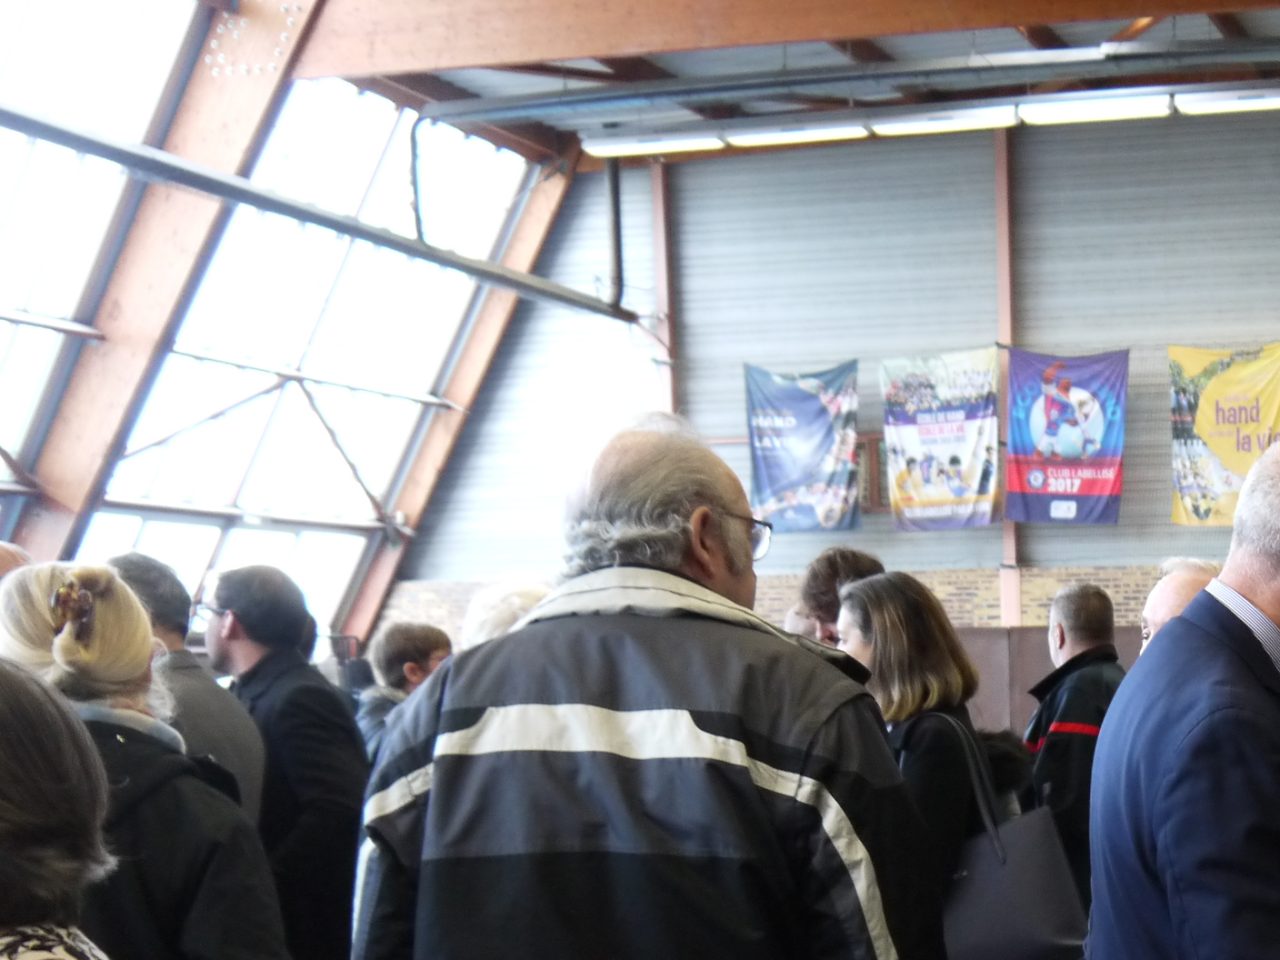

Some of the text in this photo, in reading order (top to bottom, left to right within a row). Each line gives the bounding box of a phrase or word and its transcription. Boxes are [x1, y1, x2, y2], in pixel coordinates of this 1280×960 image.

[1215, 396, 1260, 425] hand
[1236, 427, 1252, 452] la
[1047, 467, 1070, 478] CLUB
[1048, 478, 1081, 492] 2017
